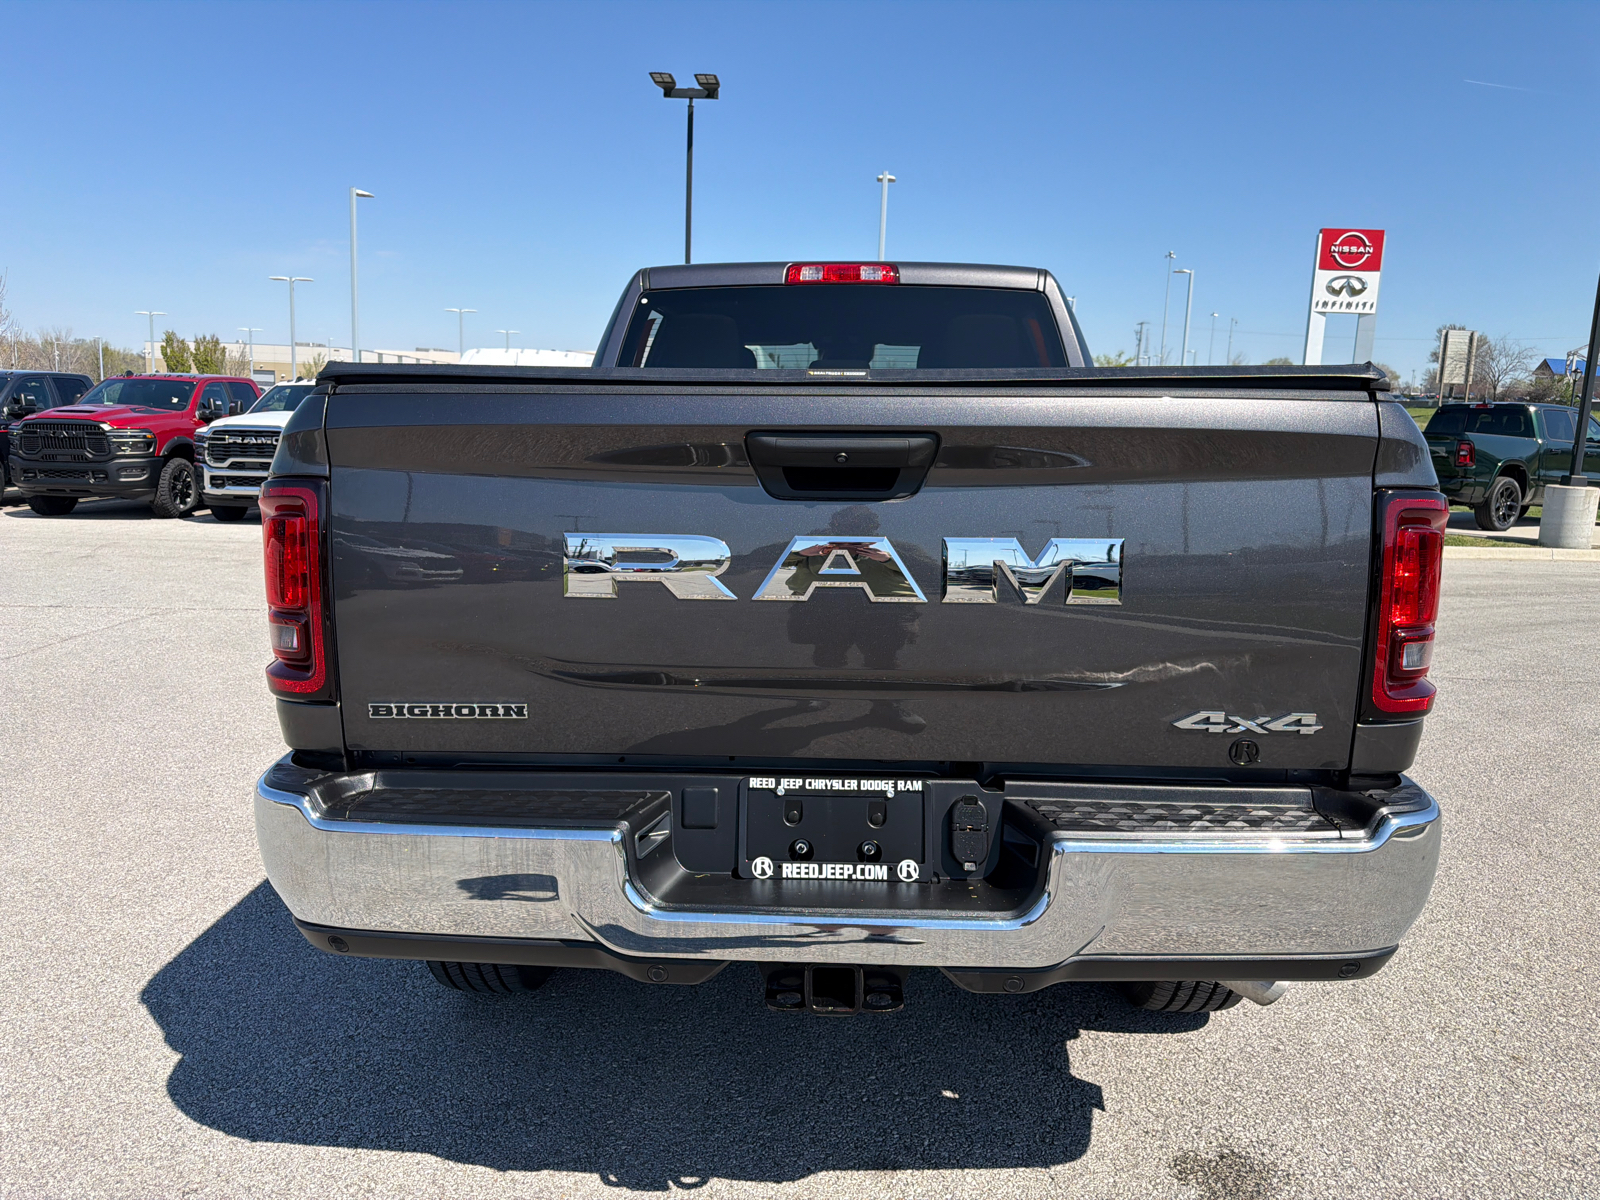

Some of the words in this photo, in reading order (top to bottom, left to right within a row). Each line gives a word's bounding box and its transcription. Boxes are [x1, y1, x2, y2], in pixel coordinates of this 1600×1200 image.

[1330, 245, 1373, 253] NISSAN
[1315, 300, 1374, 311] INFINITI
[228, 436, 272, 444] RAM
[563, 532, 1125, 605] RAM
[368, 703, 529, 719] BIGHORN
[749, 777, 775, 789] REED
[778, 778, 803, 790] JEEP
[805, 778, 858, 791] CHRYSLER
[860, 780, 895, 792] DODGE
[897, 780, 922, 791] RAM
[782, 863, 888, 880] REEDJEEP.COM
